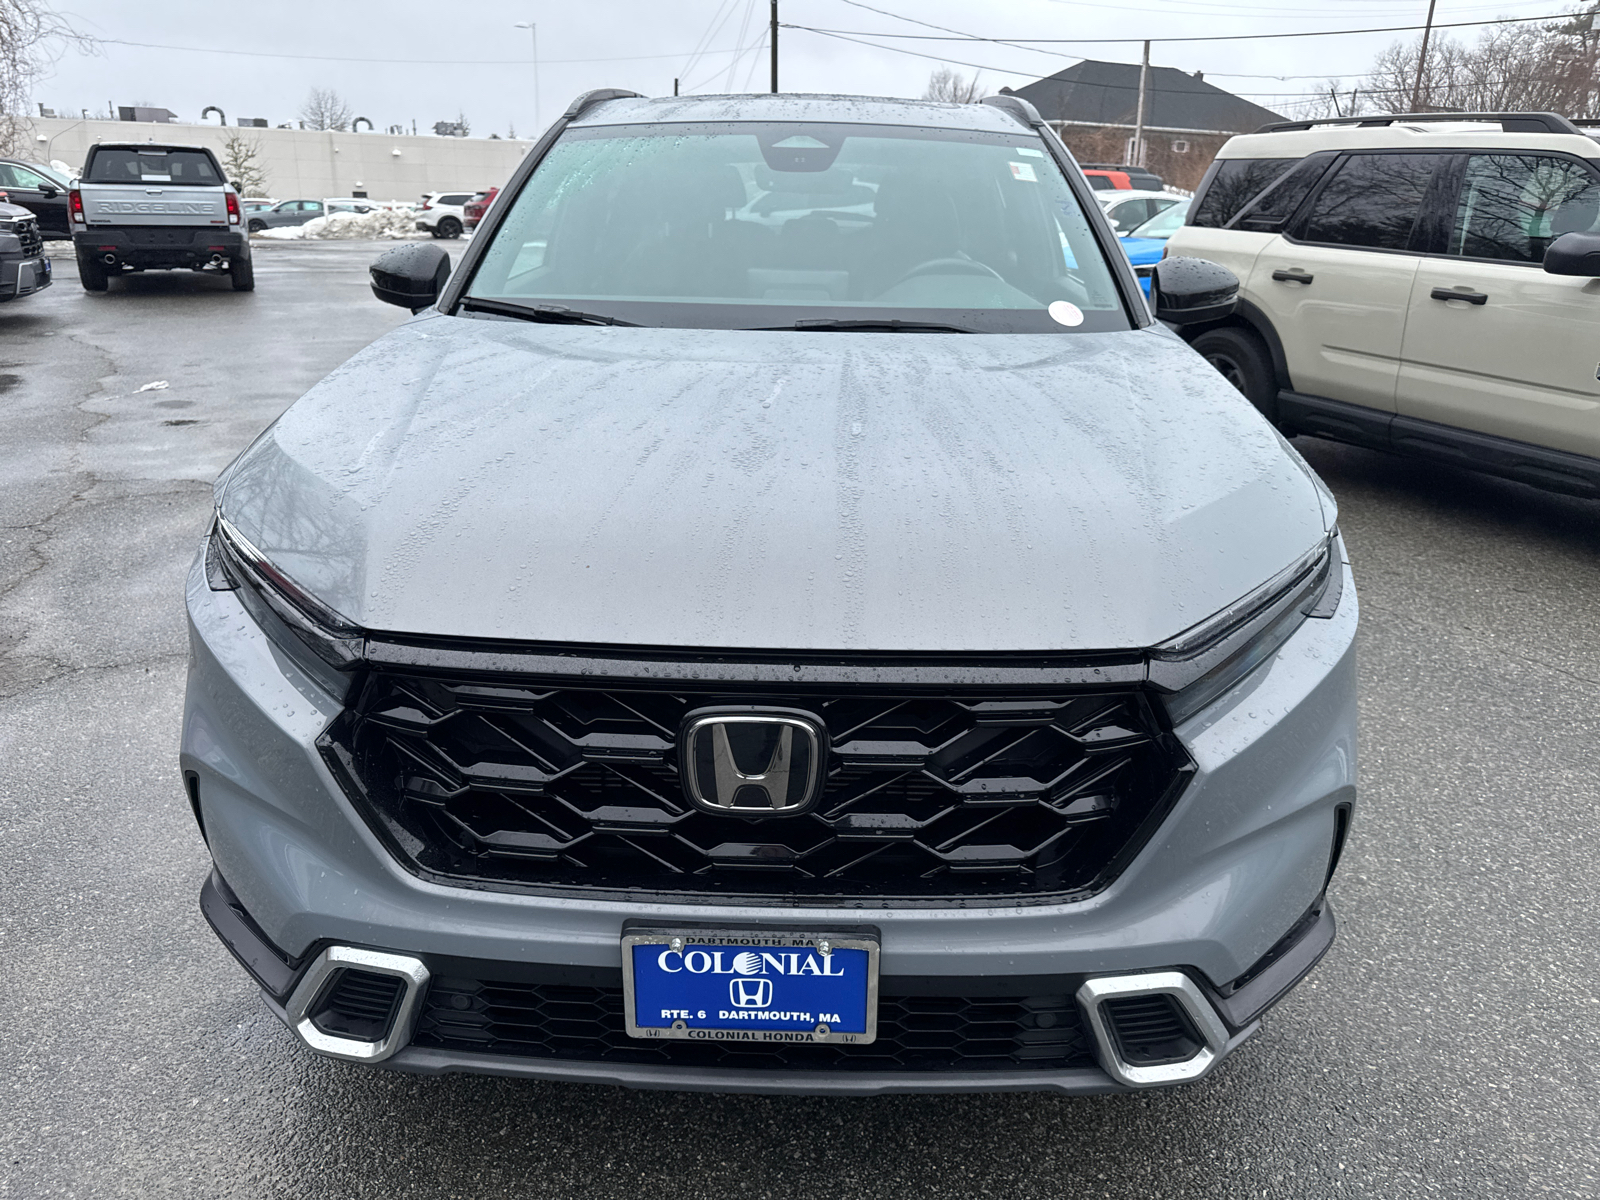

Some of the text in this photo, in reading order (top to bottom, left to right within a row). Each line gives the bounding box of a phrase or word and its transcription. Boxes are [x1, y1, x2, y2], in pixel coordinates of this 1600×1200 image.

[97, 202, 215, 215] RIDGELINE
[685, 937, 786, 947] DARTMOUTH,
[657, 950, 845, 977] COLONIAL
[661, 1009, 841, 1023] RTE. 6 DARTMOUTH, MA
[688, 1030, 814, 1042] COLONIAL HONDA
